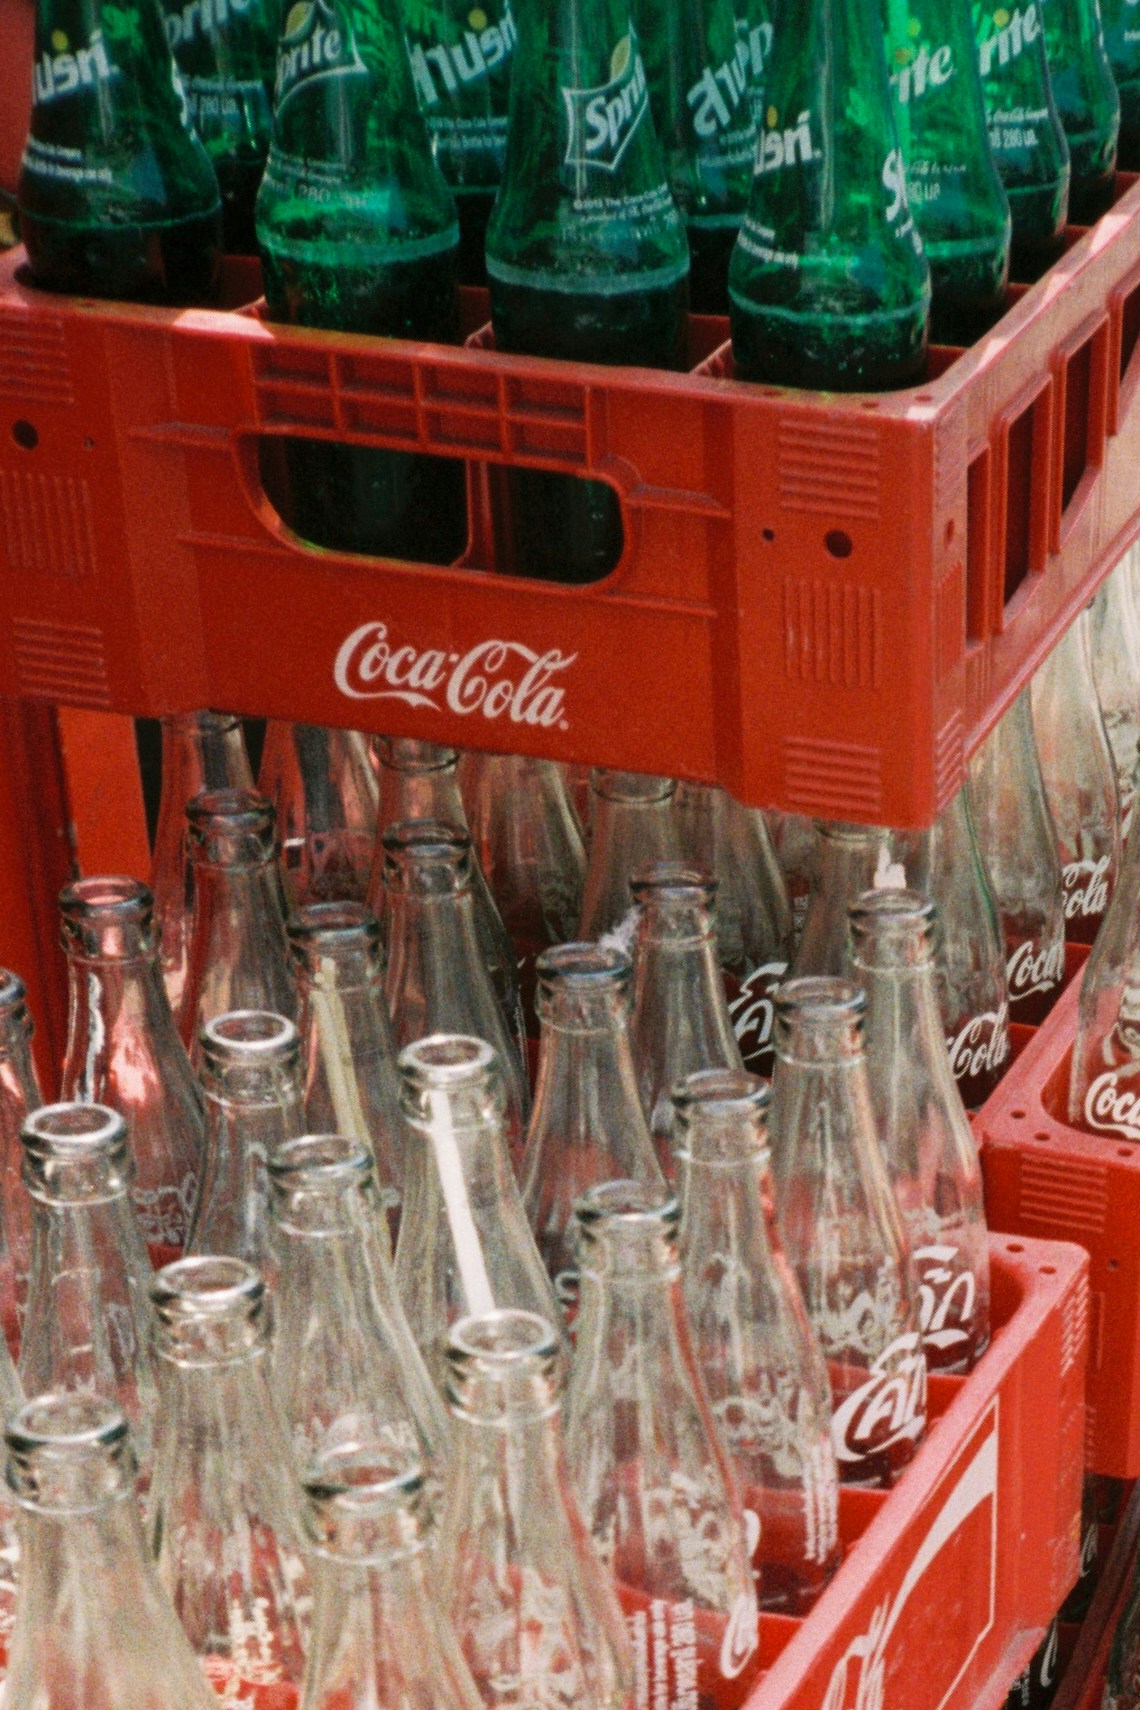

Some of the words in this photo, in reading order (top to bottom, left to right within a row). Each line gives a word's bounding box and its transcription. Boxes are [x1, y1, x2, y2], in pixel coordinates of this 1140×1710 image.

[276, 22, 341, 97] prite
[978, 3, 1041, 76] rite
[332, 621, 577, 729] Coca-Cola
